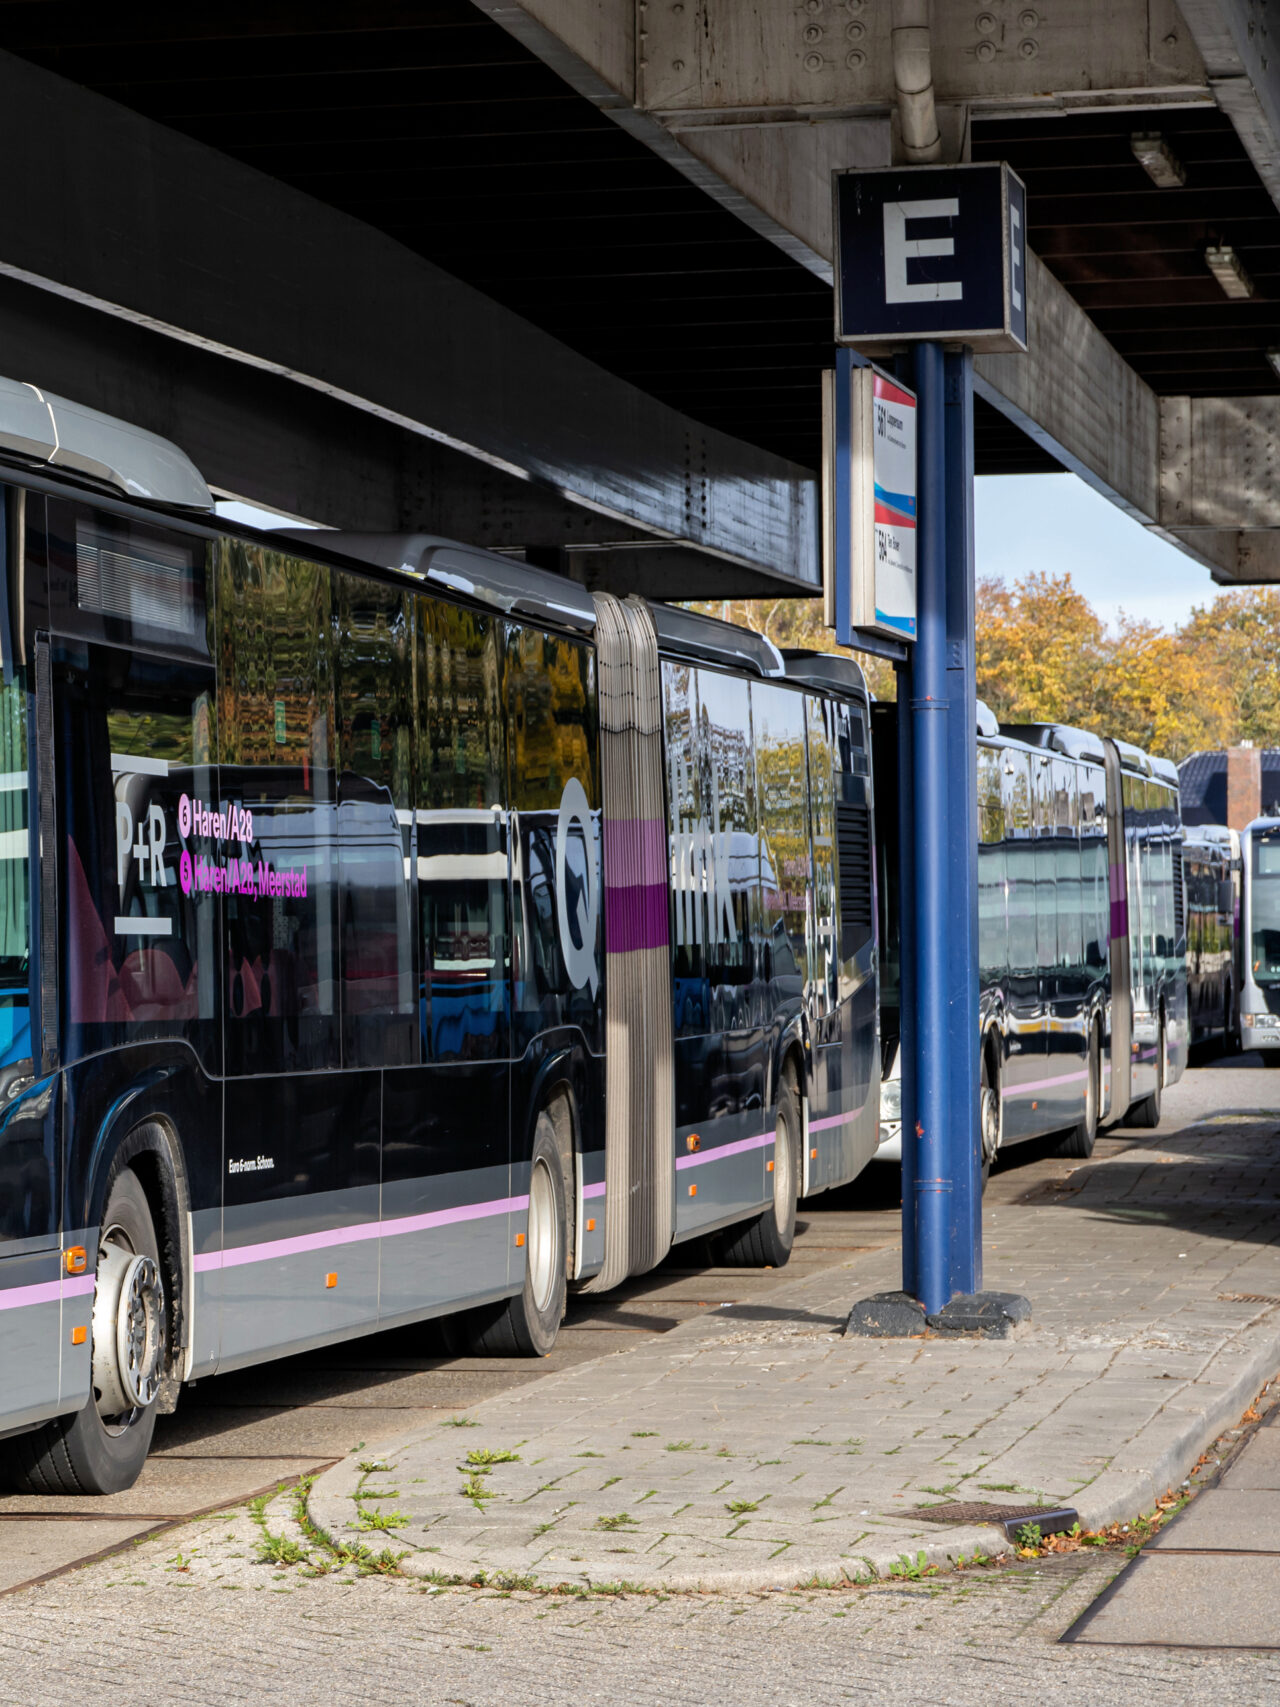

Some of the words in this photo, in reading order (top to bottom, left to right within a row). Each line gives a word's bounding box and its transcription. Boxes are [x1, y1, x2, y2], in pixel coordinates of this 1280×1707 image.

[883, 197, 963, 304] E
[1010, 203, 1022, 312] E
[116, 801, 168, 887] P+R
[192, 799, 254, 843] Haren/A28
[193, 854, 258, 902] Haren/A28,
[258, 860, 308, 898] Meerstad
[556, 777, 599, 1003] Q
